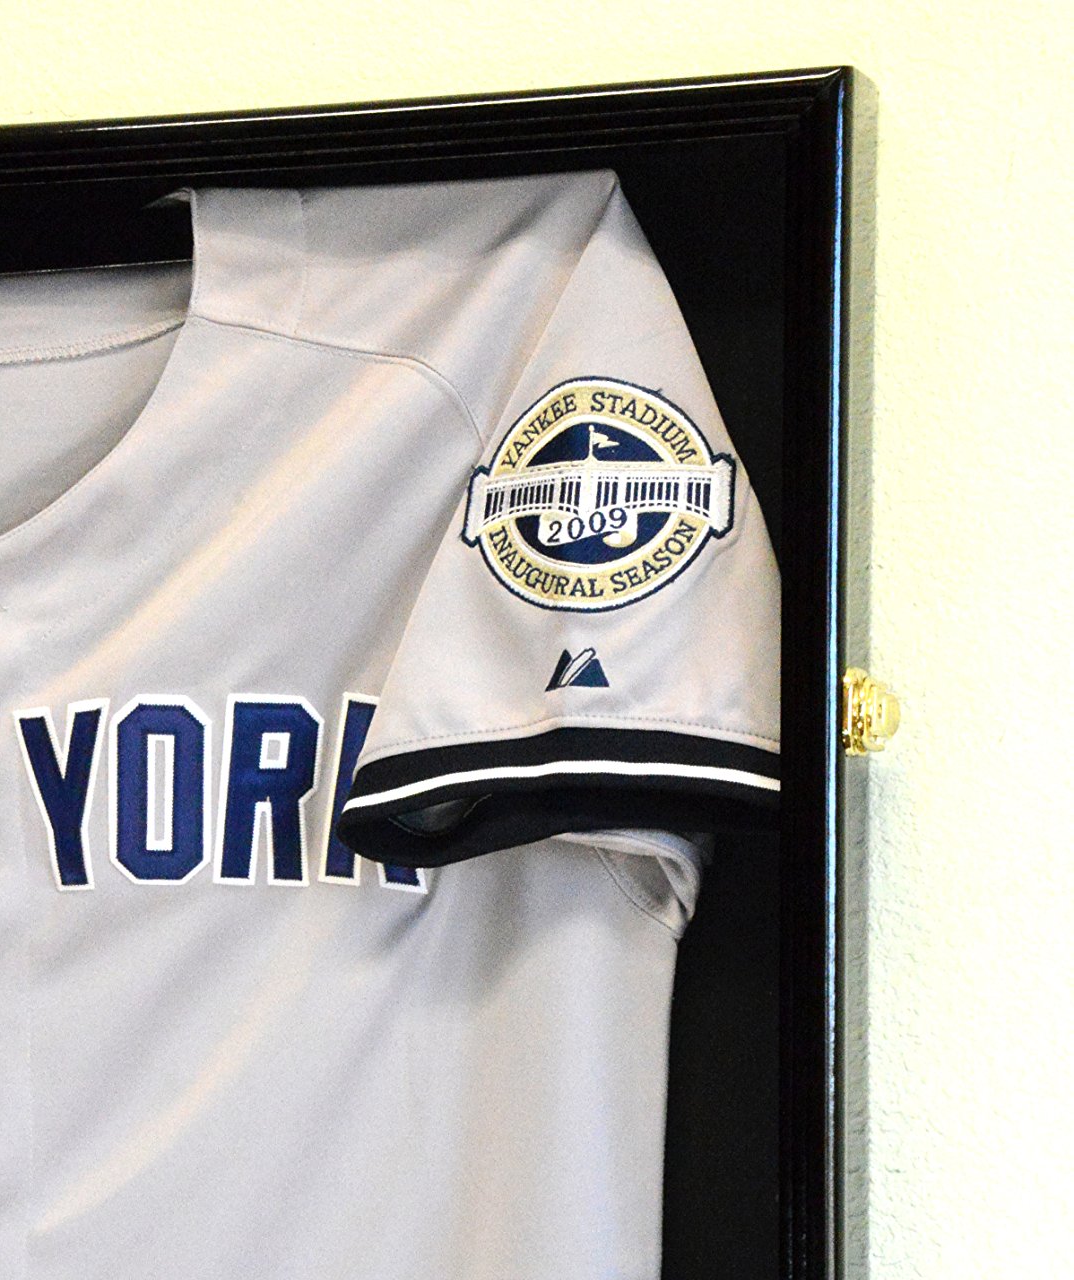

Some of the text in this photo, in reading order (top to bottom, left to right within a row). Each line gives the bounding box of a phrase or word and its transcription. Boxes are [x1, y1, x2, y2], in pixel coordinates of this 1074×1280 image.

[502, 391, 697, 468] YANKEE STADIUM
[489, 521, 697, 597] INAUGURAL SEASON
[548, 506, 628, 543] 2009
